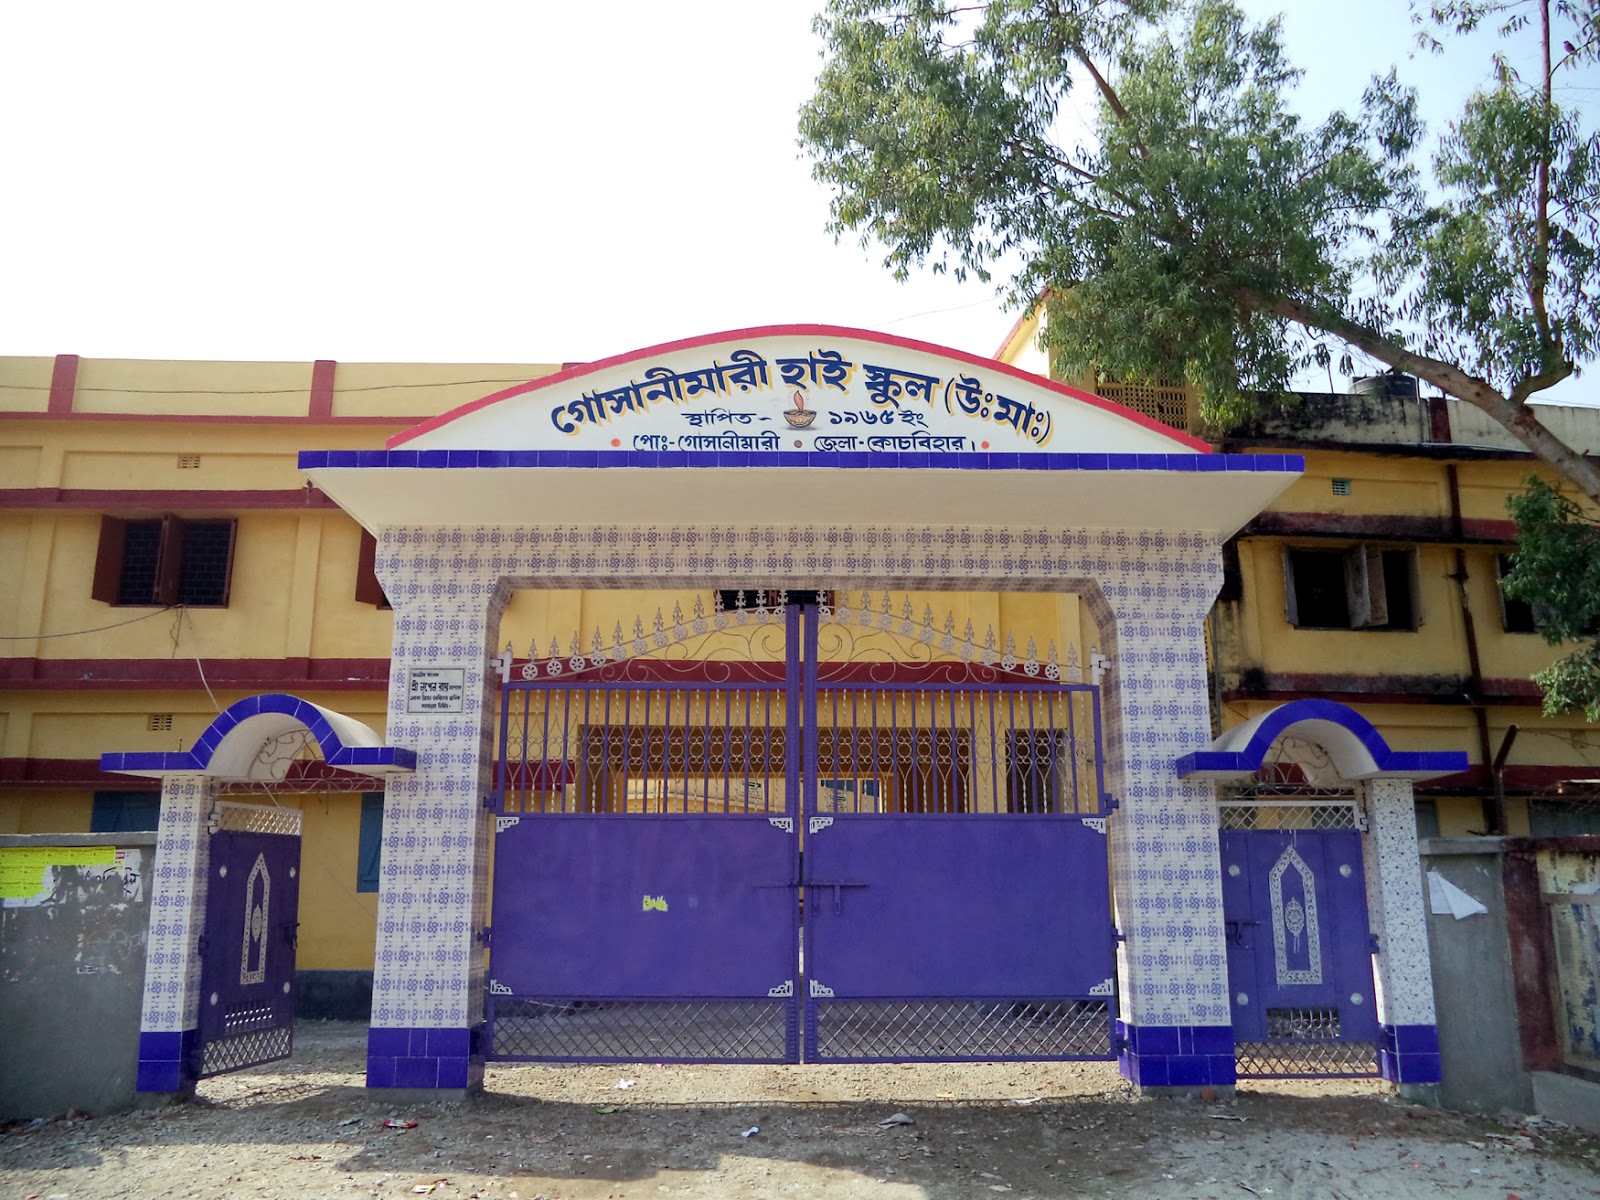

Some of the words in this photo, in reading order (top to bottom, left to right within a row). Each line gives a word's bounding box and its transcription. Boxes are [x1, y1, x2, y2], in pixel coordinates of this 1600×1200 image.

[551, 350, 769, 434] গোসানীমারী
[775, 348, 853, 392] হাই
[862, 363, 940, 409] স্কুল
[828, 409, 894, 425] ১৯৬৫
[898, 409, 929, 429] ইং
